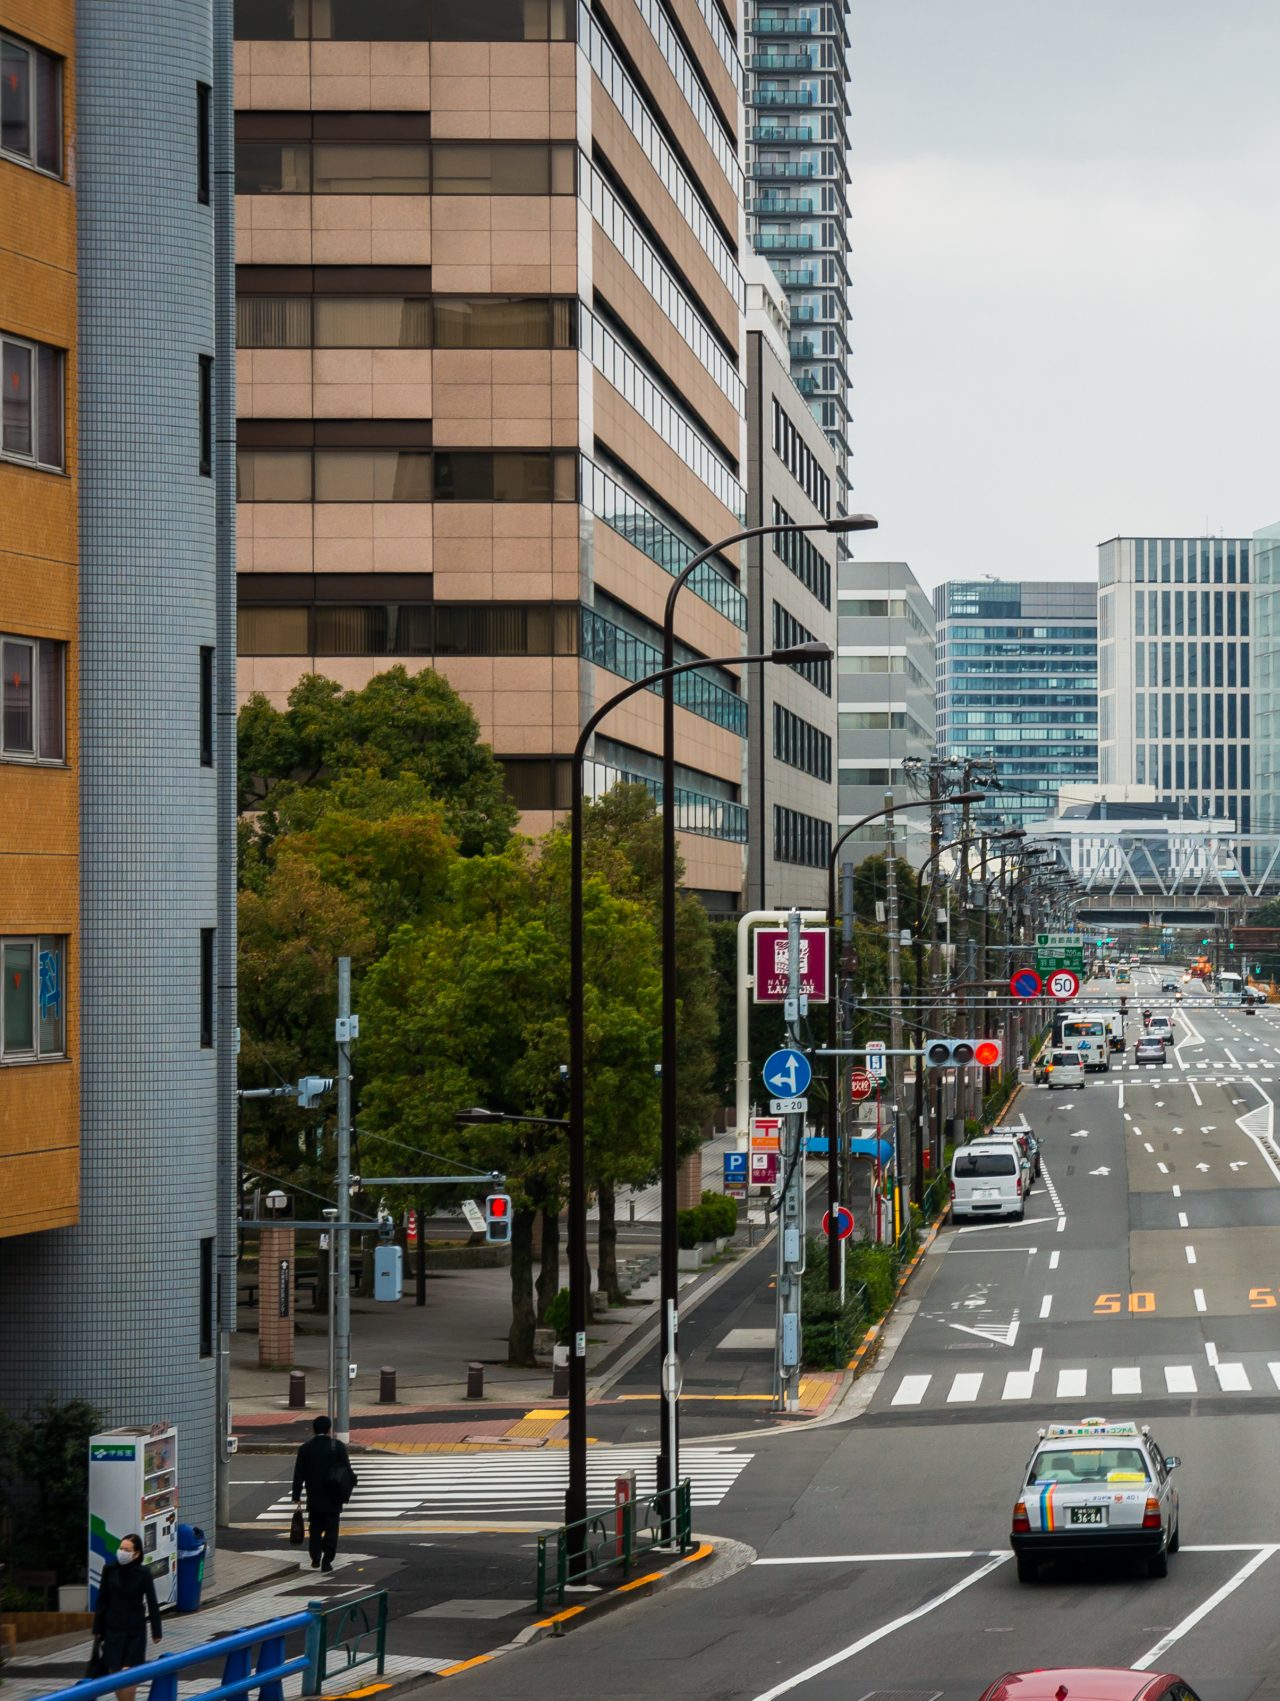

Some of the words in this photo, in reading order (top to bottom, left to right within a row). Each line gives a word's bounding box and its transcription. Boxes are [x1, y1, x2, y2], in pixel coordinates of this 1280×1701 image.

[1054, 978, 1072, 992] 50
[852, 1080, 869, 1091] 火栓
[730, 1155, 743, 1171] P
[1093, 1292, 1156, 1313] 50
[1077, 1513, 1101, 1523] 36-84
